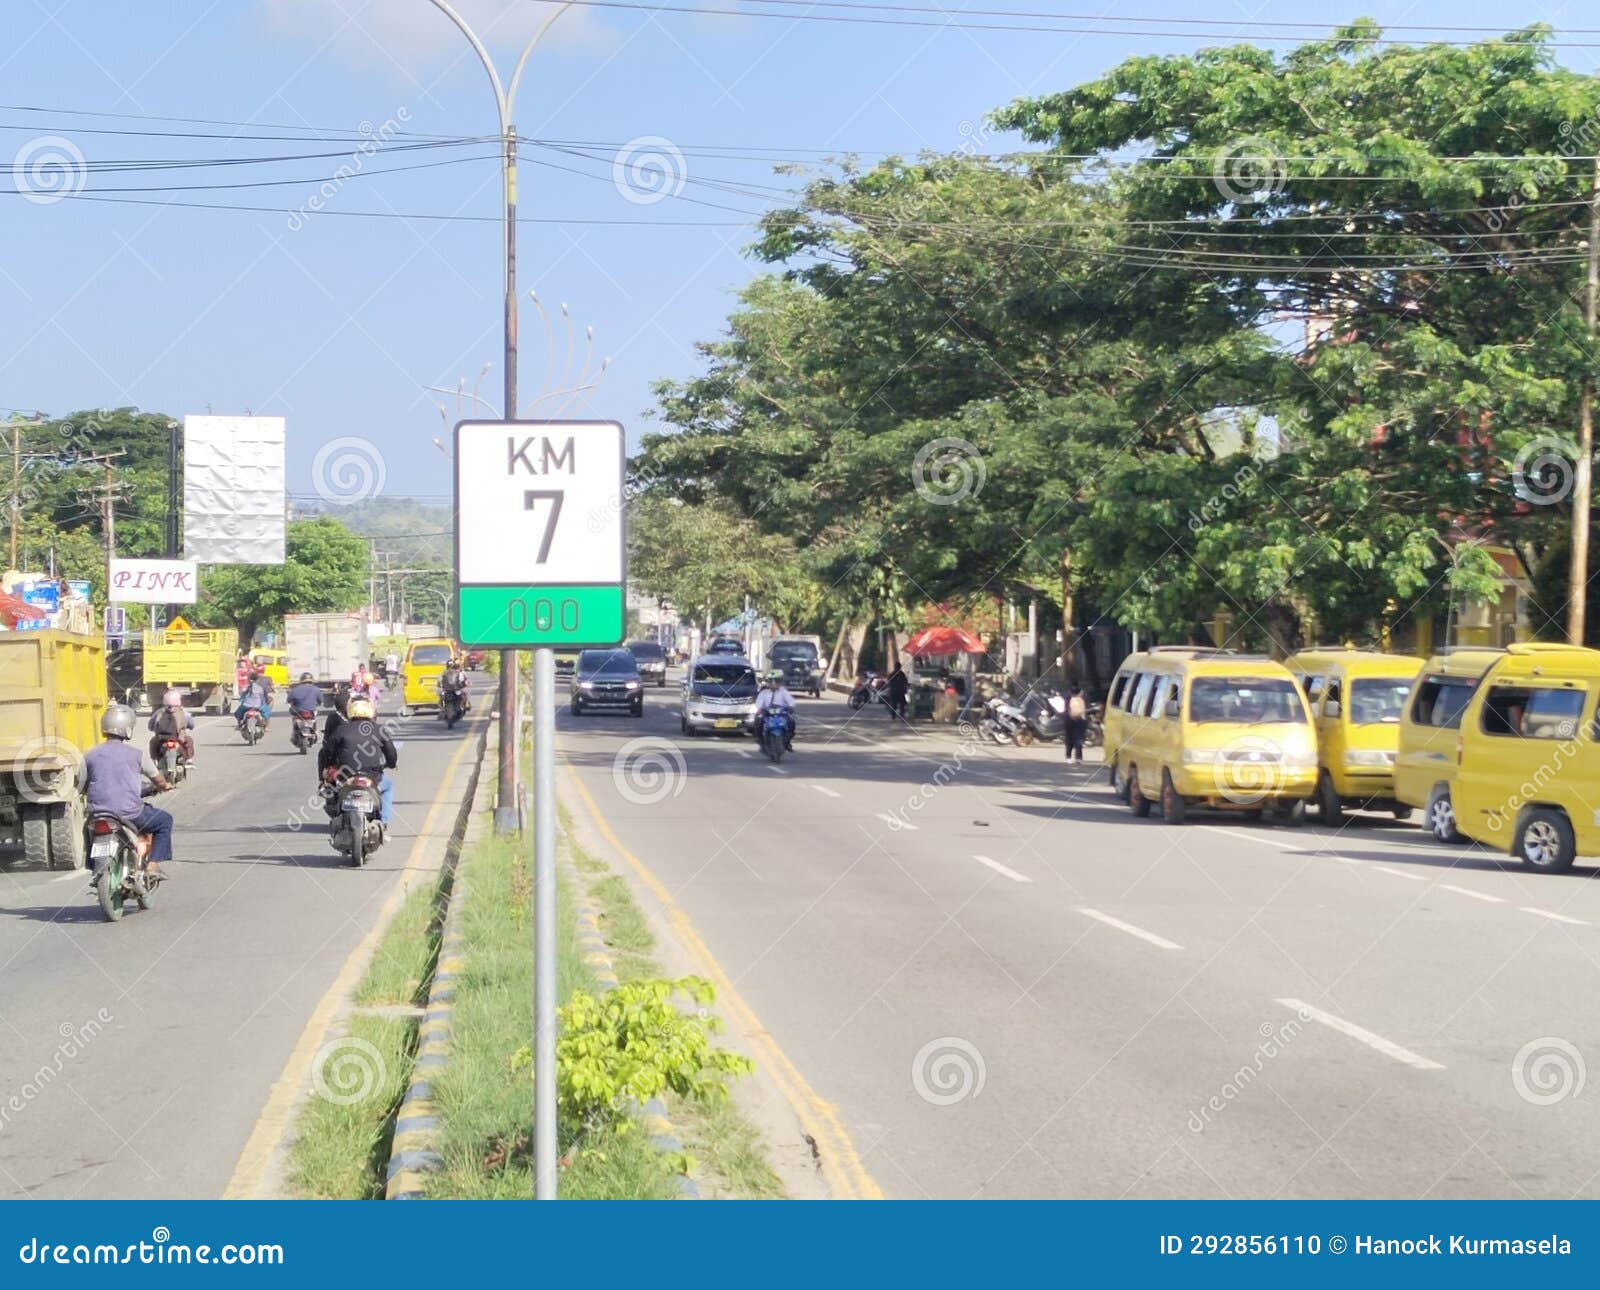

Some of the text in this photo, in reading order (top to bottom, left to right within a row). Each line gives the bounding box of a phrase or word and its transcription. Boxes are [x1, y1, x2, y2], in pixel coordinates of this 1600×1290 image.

[507, 436, 576, 475] KM
[523, 489, 565, 564] 7
[113, 570, 192, 591] PINK
[507, 598, 579, 632] 000
